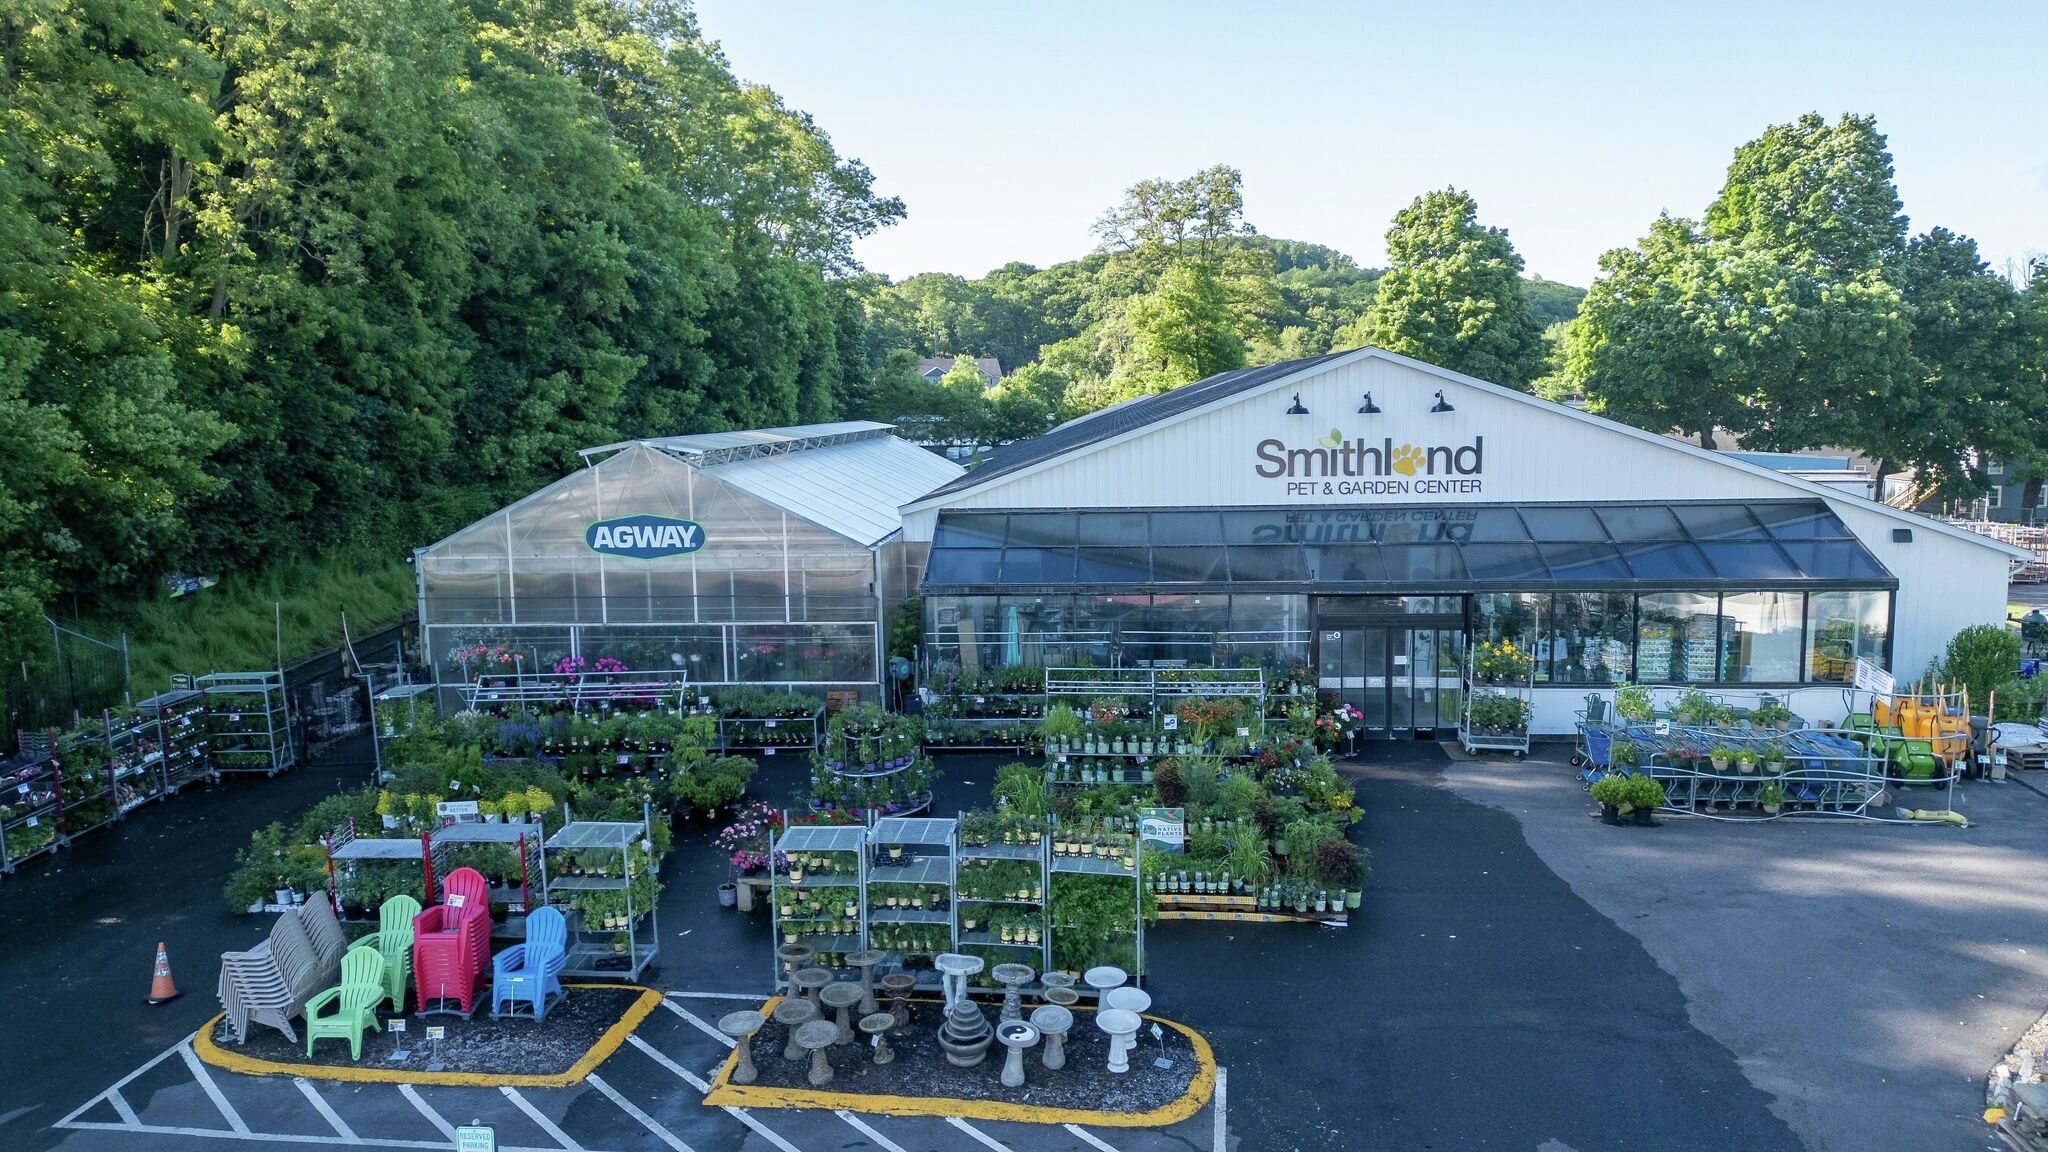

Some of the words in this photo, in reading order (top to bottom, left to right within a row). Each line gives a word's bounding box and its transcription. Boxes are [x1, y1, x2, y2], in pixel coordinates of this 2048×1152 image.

[1255, 434, 1483, 478] Smithlnd
[1287, 482, 1318, 495] PET
[1322, 482, 1333, 495] &
[1338, 481, 1408, 495] GARDEN
[1415, 480, 1482, 494] CENTER
[593, 525, 697, 549] AGWAY
